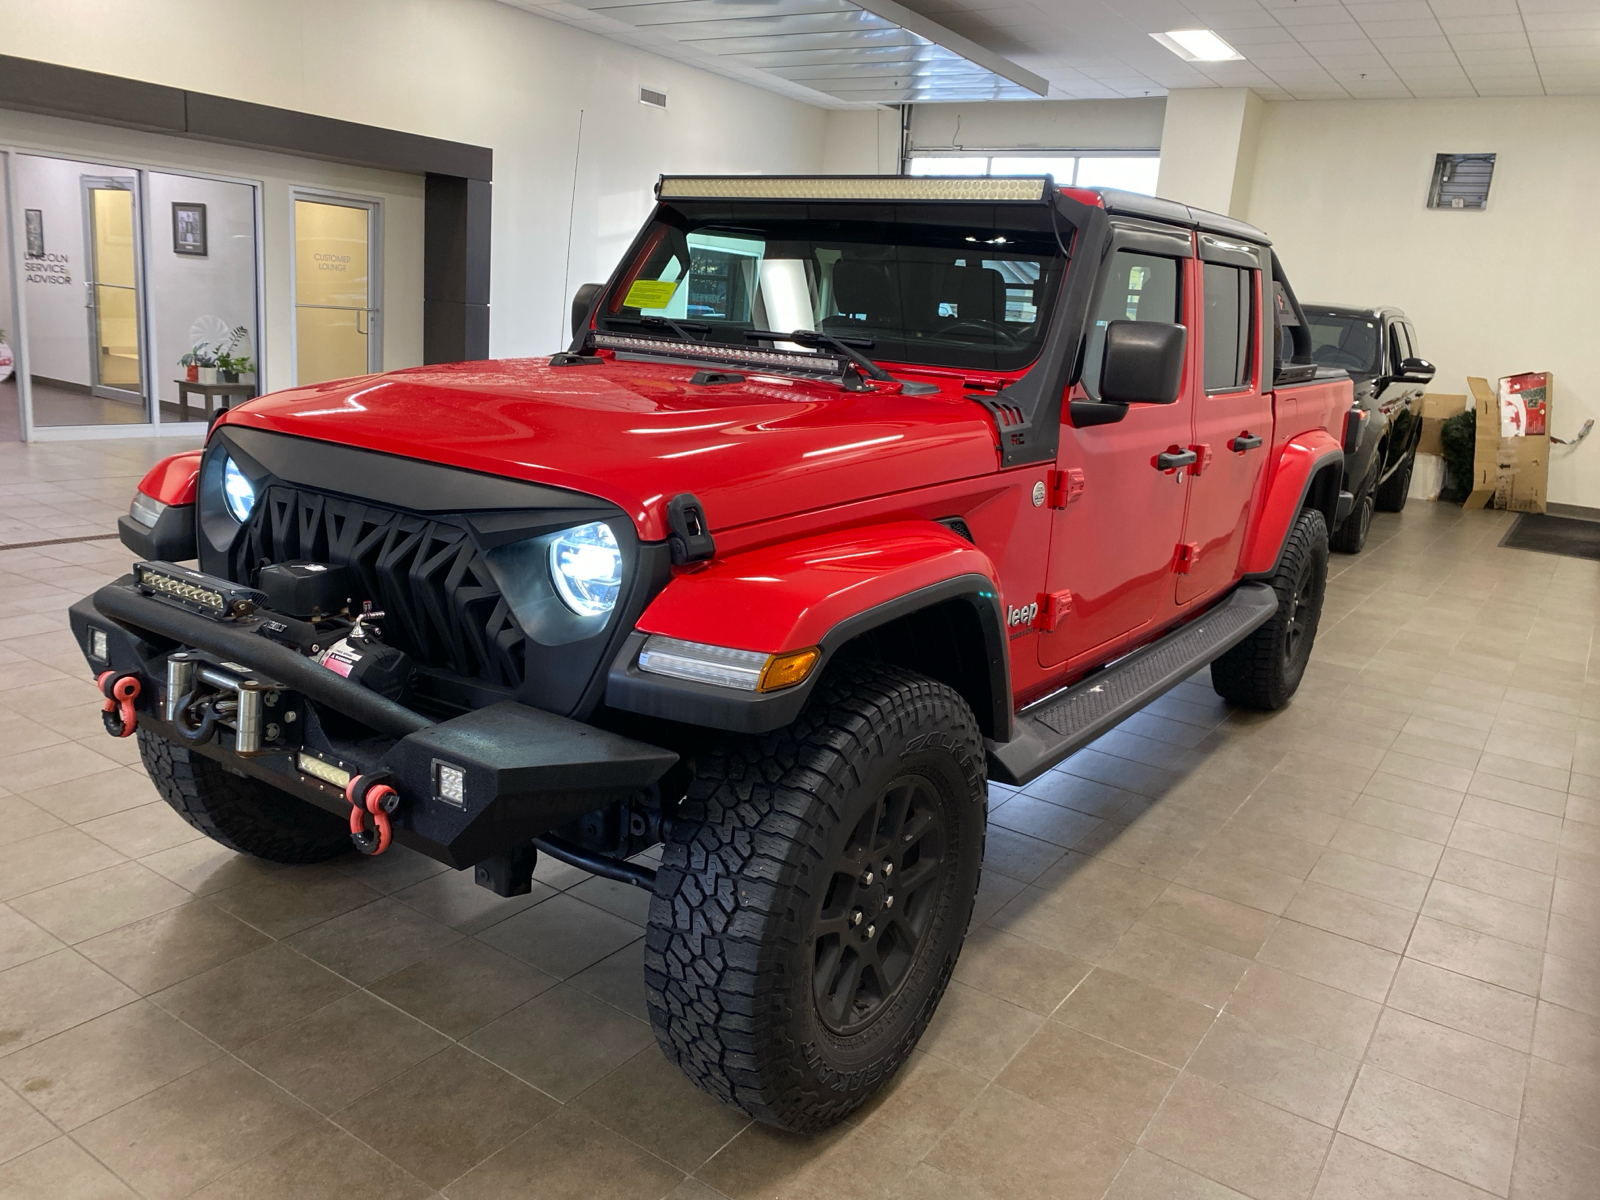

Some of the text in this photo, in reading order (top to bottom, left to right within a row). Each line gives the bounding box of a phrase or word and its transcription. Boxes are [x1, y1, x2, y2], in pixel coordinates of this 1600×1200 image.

[24, 252, 68, 262] LINCOLN
[314, 253, 351, 263] CUSTOMER
[24, 263, 65, 273] SERVICE
[319, 263, 346, 272] LOUNGE
[26, 274, 72, 284] ADVISOR
[1007, 602, 1038, 627] Jeep
[899, 731, 980, 802] FALKEN
